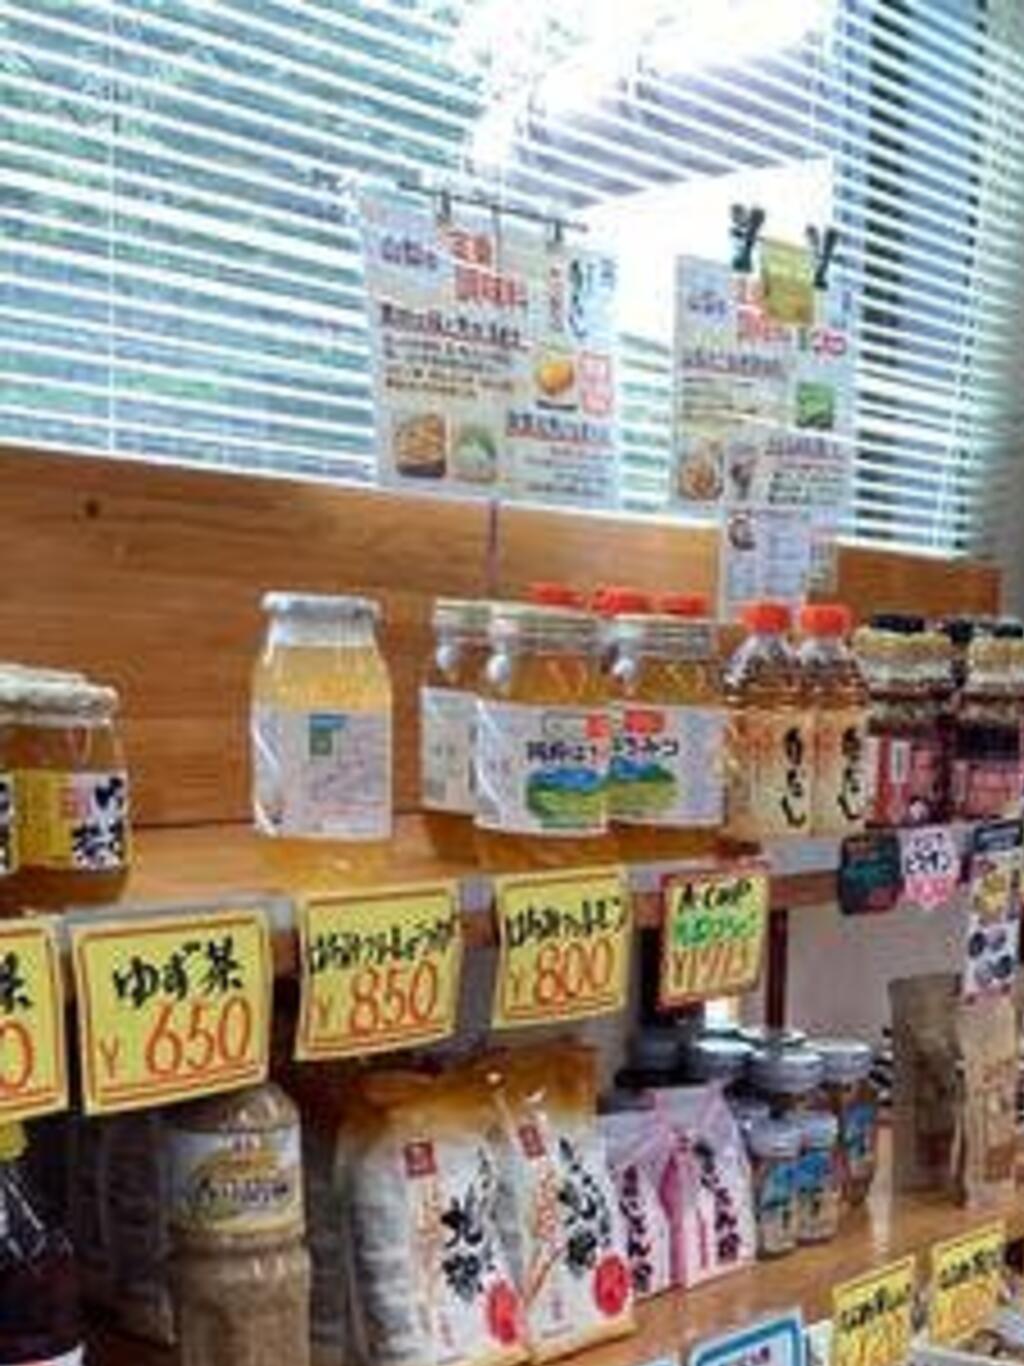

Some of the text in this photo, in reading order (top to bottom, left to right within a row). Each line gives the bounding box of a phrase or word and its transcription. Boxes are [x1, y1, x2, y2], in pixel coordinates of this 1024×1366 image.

[113, 938, 244, 1008] ゆず茶
[349, 961, 439, 1036] 850
[535, 937, 616, 1006] 800
[145, 998, 252, 1078] 650
